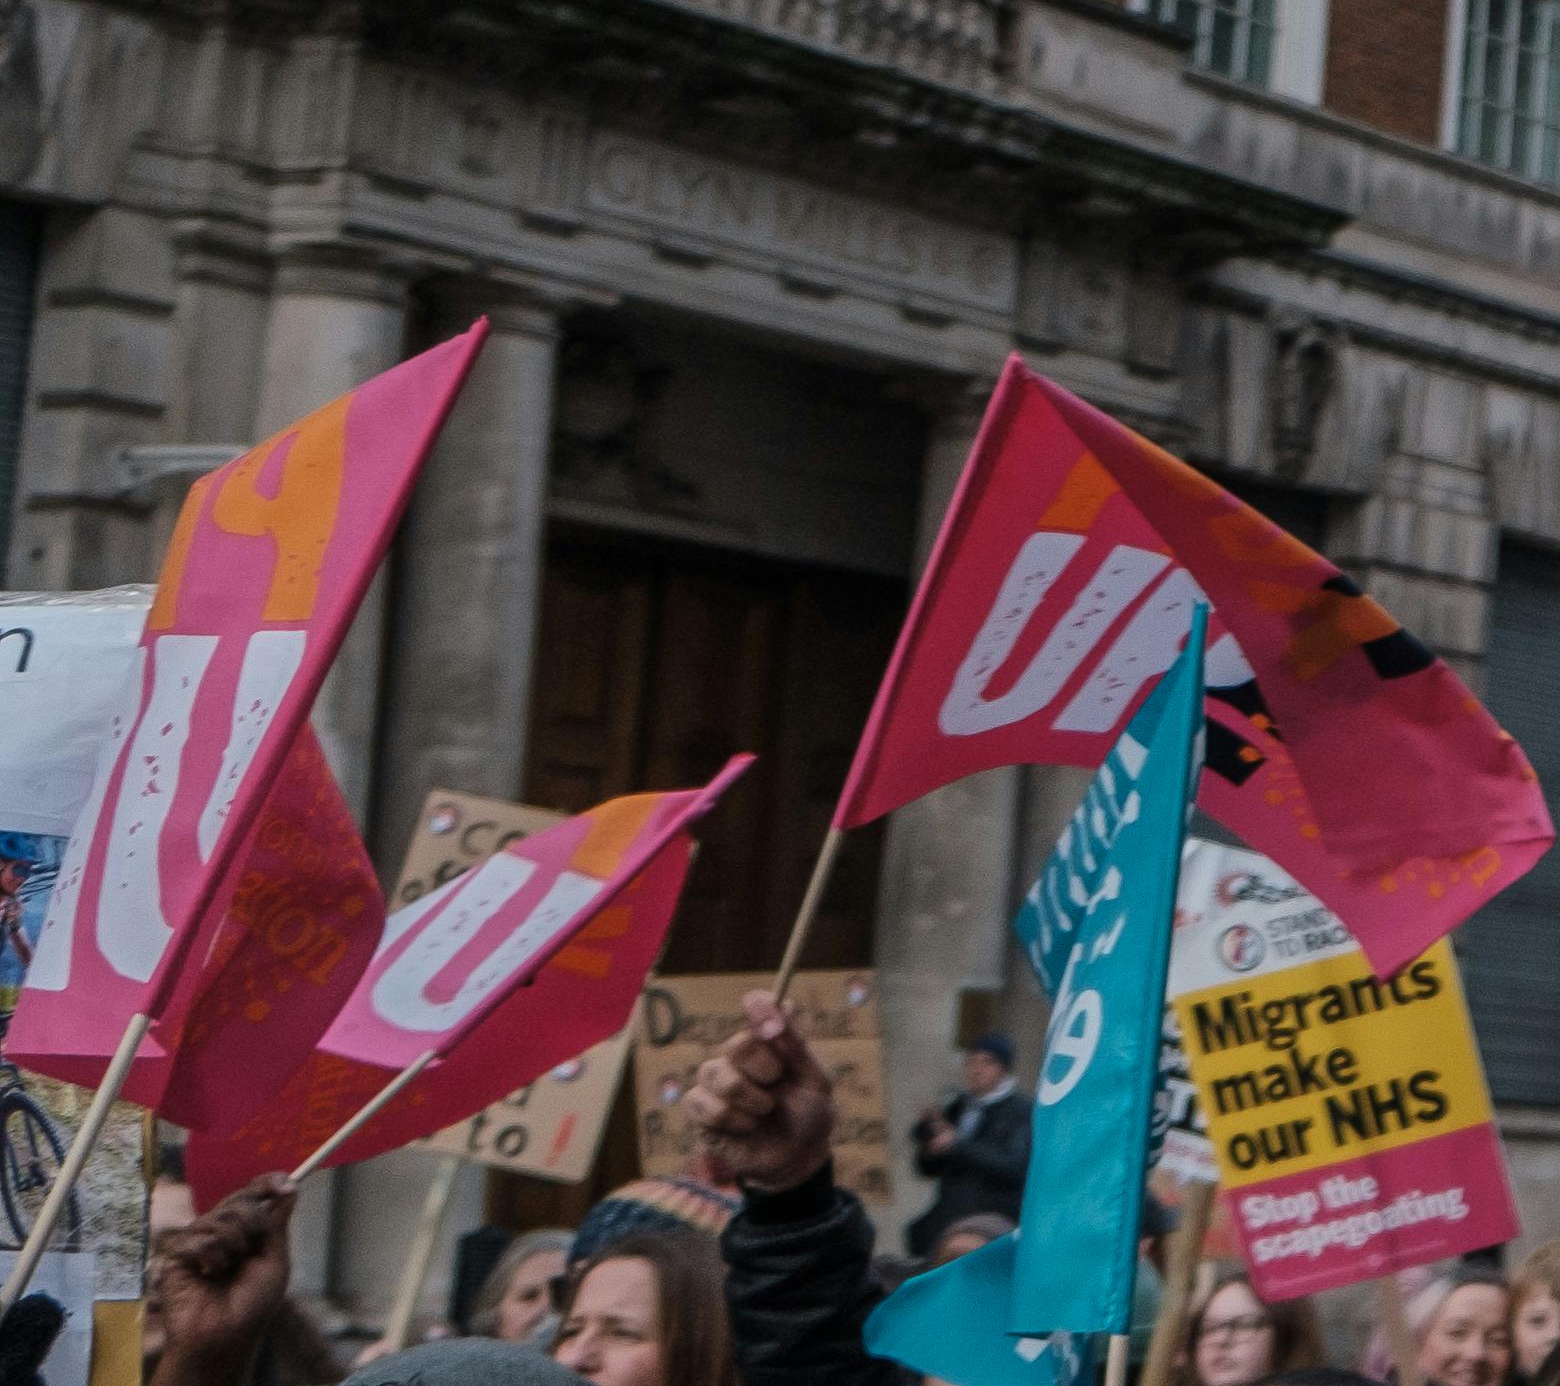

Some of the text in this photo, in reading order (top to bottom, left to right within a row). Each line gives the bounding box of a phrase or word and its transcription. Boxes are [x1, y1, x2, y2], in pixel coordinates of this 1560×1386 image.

[1190, 960, 1442, 1055] Migrants
[1210, 1048, 1361, 1116] make
[1226, 1070, 1450, 1170] our NHS
[1241, 1175, 1378, 1228] Stop the
[1253, 1187, 1469, 1264] scapegoating
